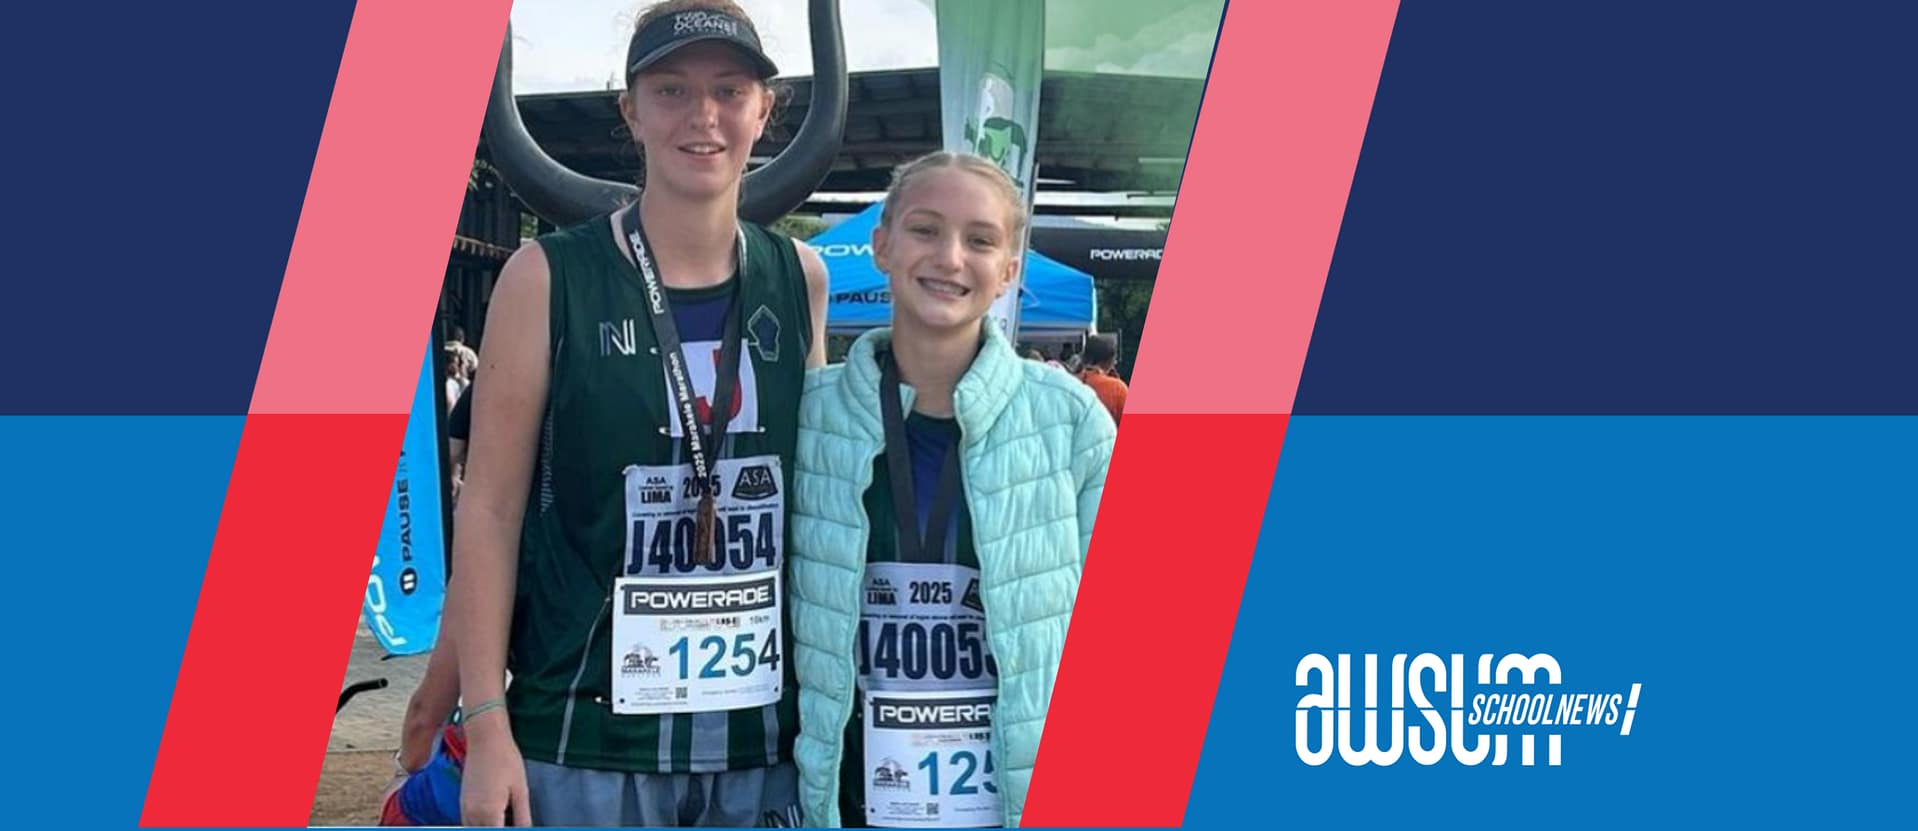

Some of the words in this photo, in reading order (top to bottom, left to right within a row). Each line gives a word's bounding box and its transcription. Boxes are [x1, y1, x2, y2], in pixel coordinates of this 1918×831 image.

[629, 229, 664, 315] POWERADE
[669, 351, 690, 402] Marathon
[692, 451, 707, 479] 2025
[739, 468, 772, 486] ASA
[645, 477, 667, 485] ASA
[682, 474, 722, 499] 205
[640, 490, 672, 504] LIMA
[396, 479, 413, 563] PAUSE
[631, 585, 770, 609] POWERADE
[867, 591, 897, 605] LIMA
[909, 581, 953, 605] 2025
[668, 628, 780, 681] 1254
